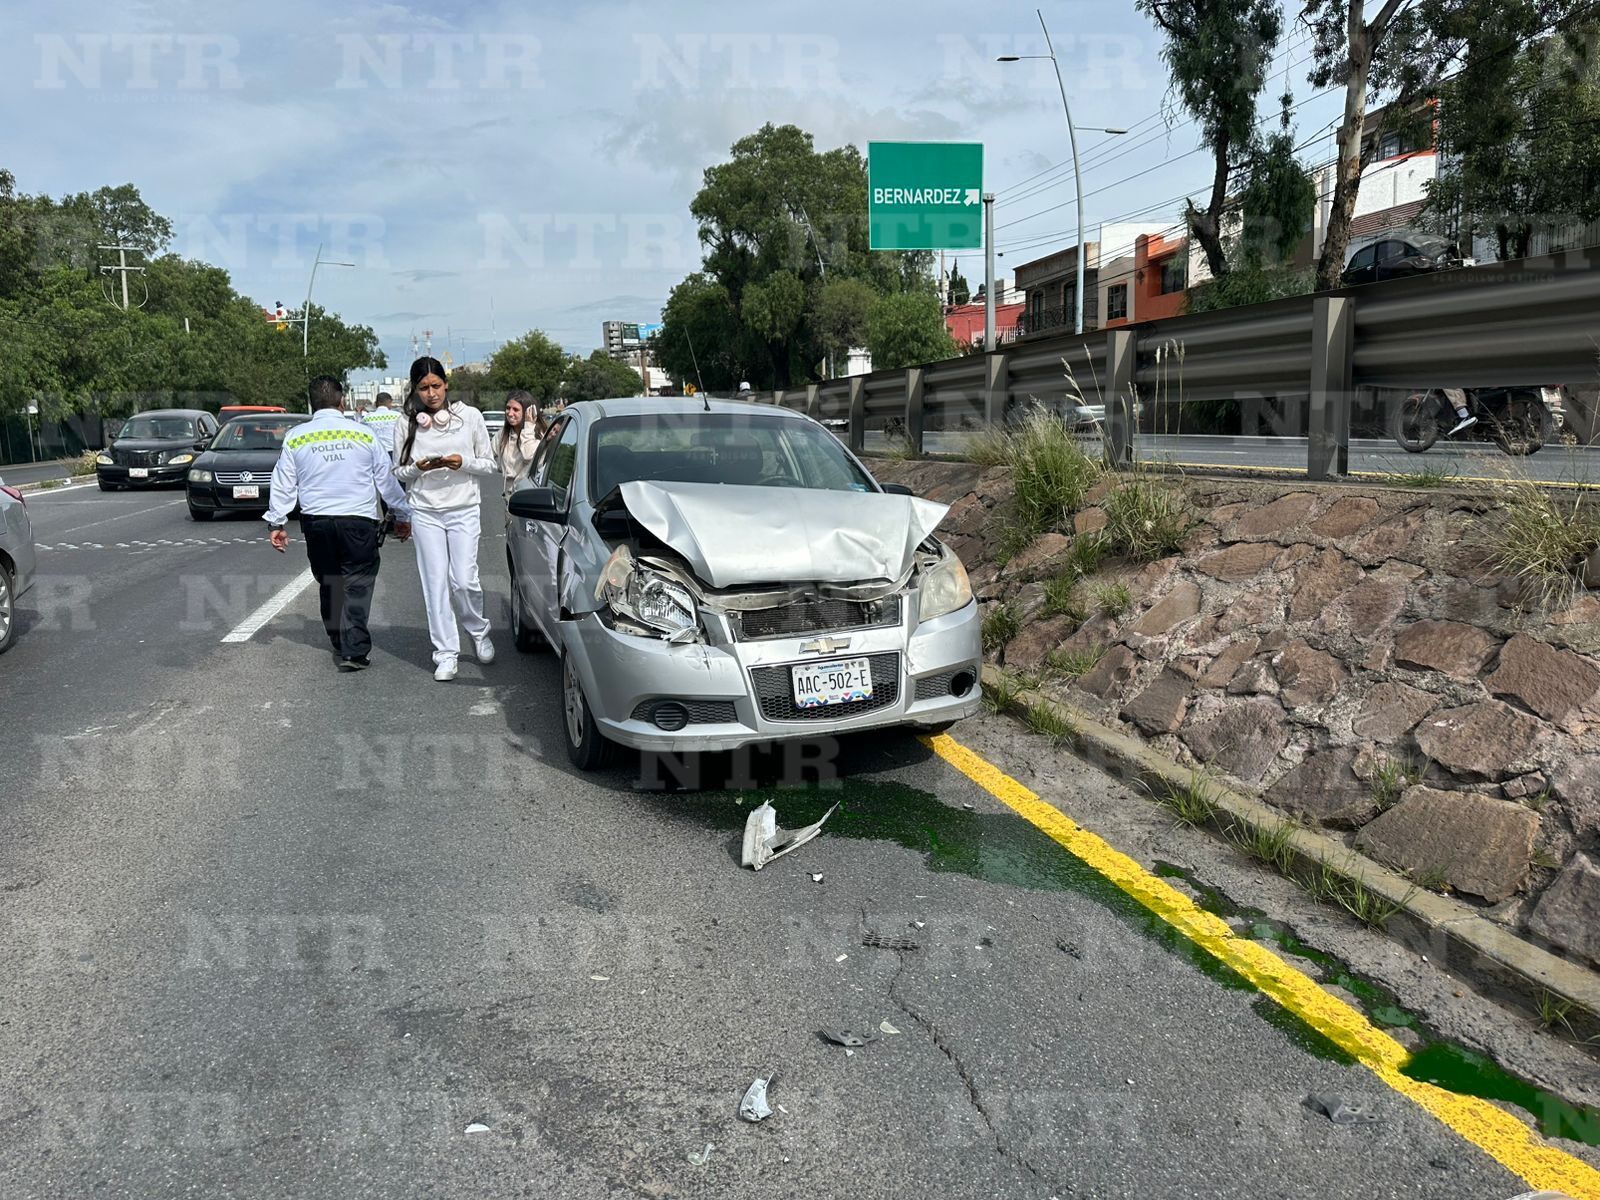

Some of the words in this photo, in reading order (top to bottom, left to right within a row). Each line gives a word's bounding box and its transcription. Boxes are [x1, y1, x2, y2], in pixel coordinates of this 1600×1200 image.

[874, 188, 961, 204] BERNARDEZ
[311, 441, 354, 454] POLICÍA
[322, 454, 345, 463] VIAL
[798, 669, 869, 695] AAC-502-E
